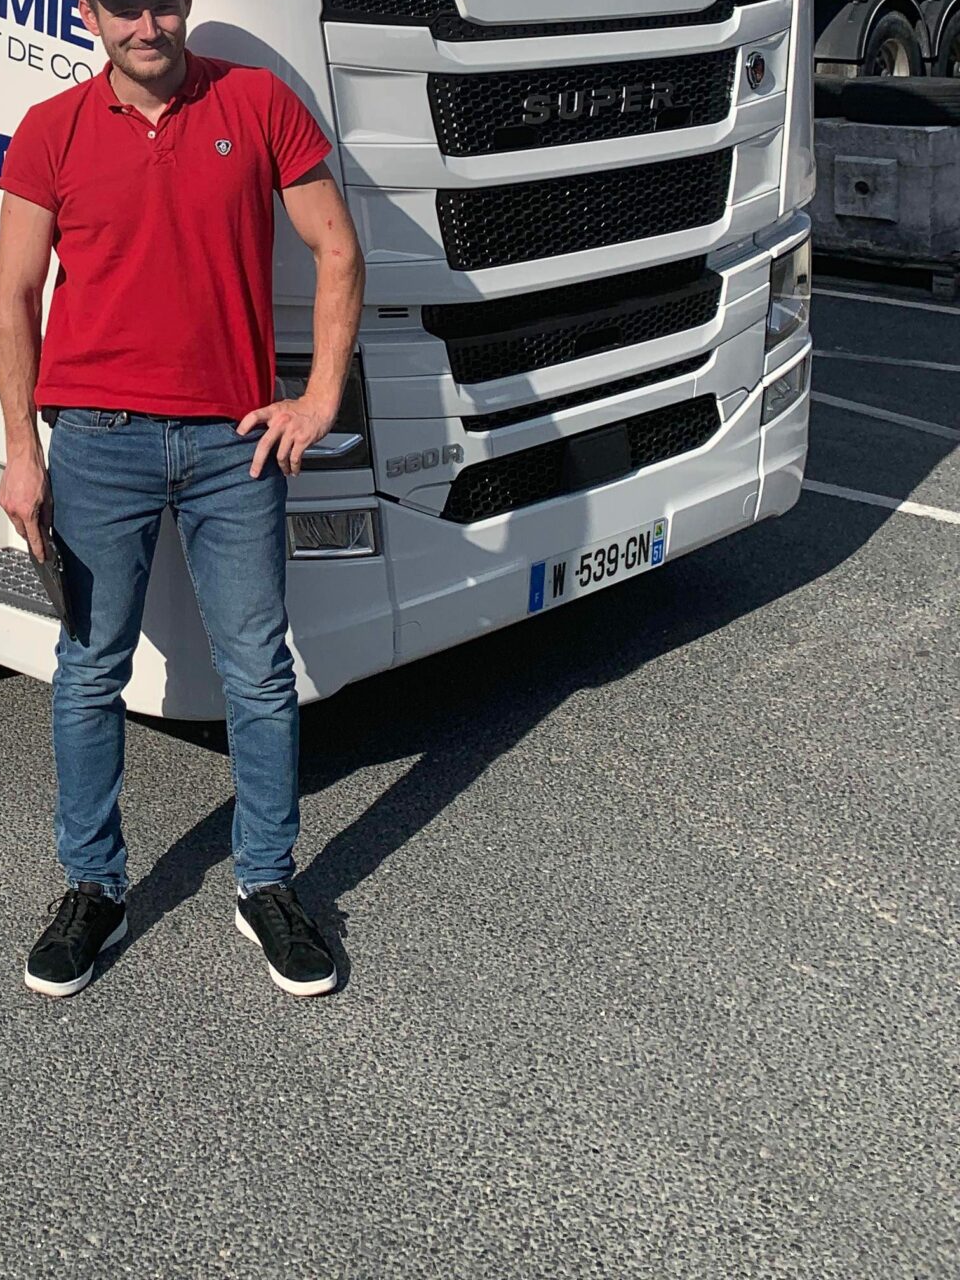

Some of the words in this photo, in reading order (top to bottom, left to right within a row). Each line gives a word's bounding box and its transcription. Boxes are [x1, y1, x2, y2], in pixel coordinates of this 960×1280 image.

[8, 36, 44, 72] DE
[522, 82, 675, 124] SUPER
[652, 542, 663, 561] 51
